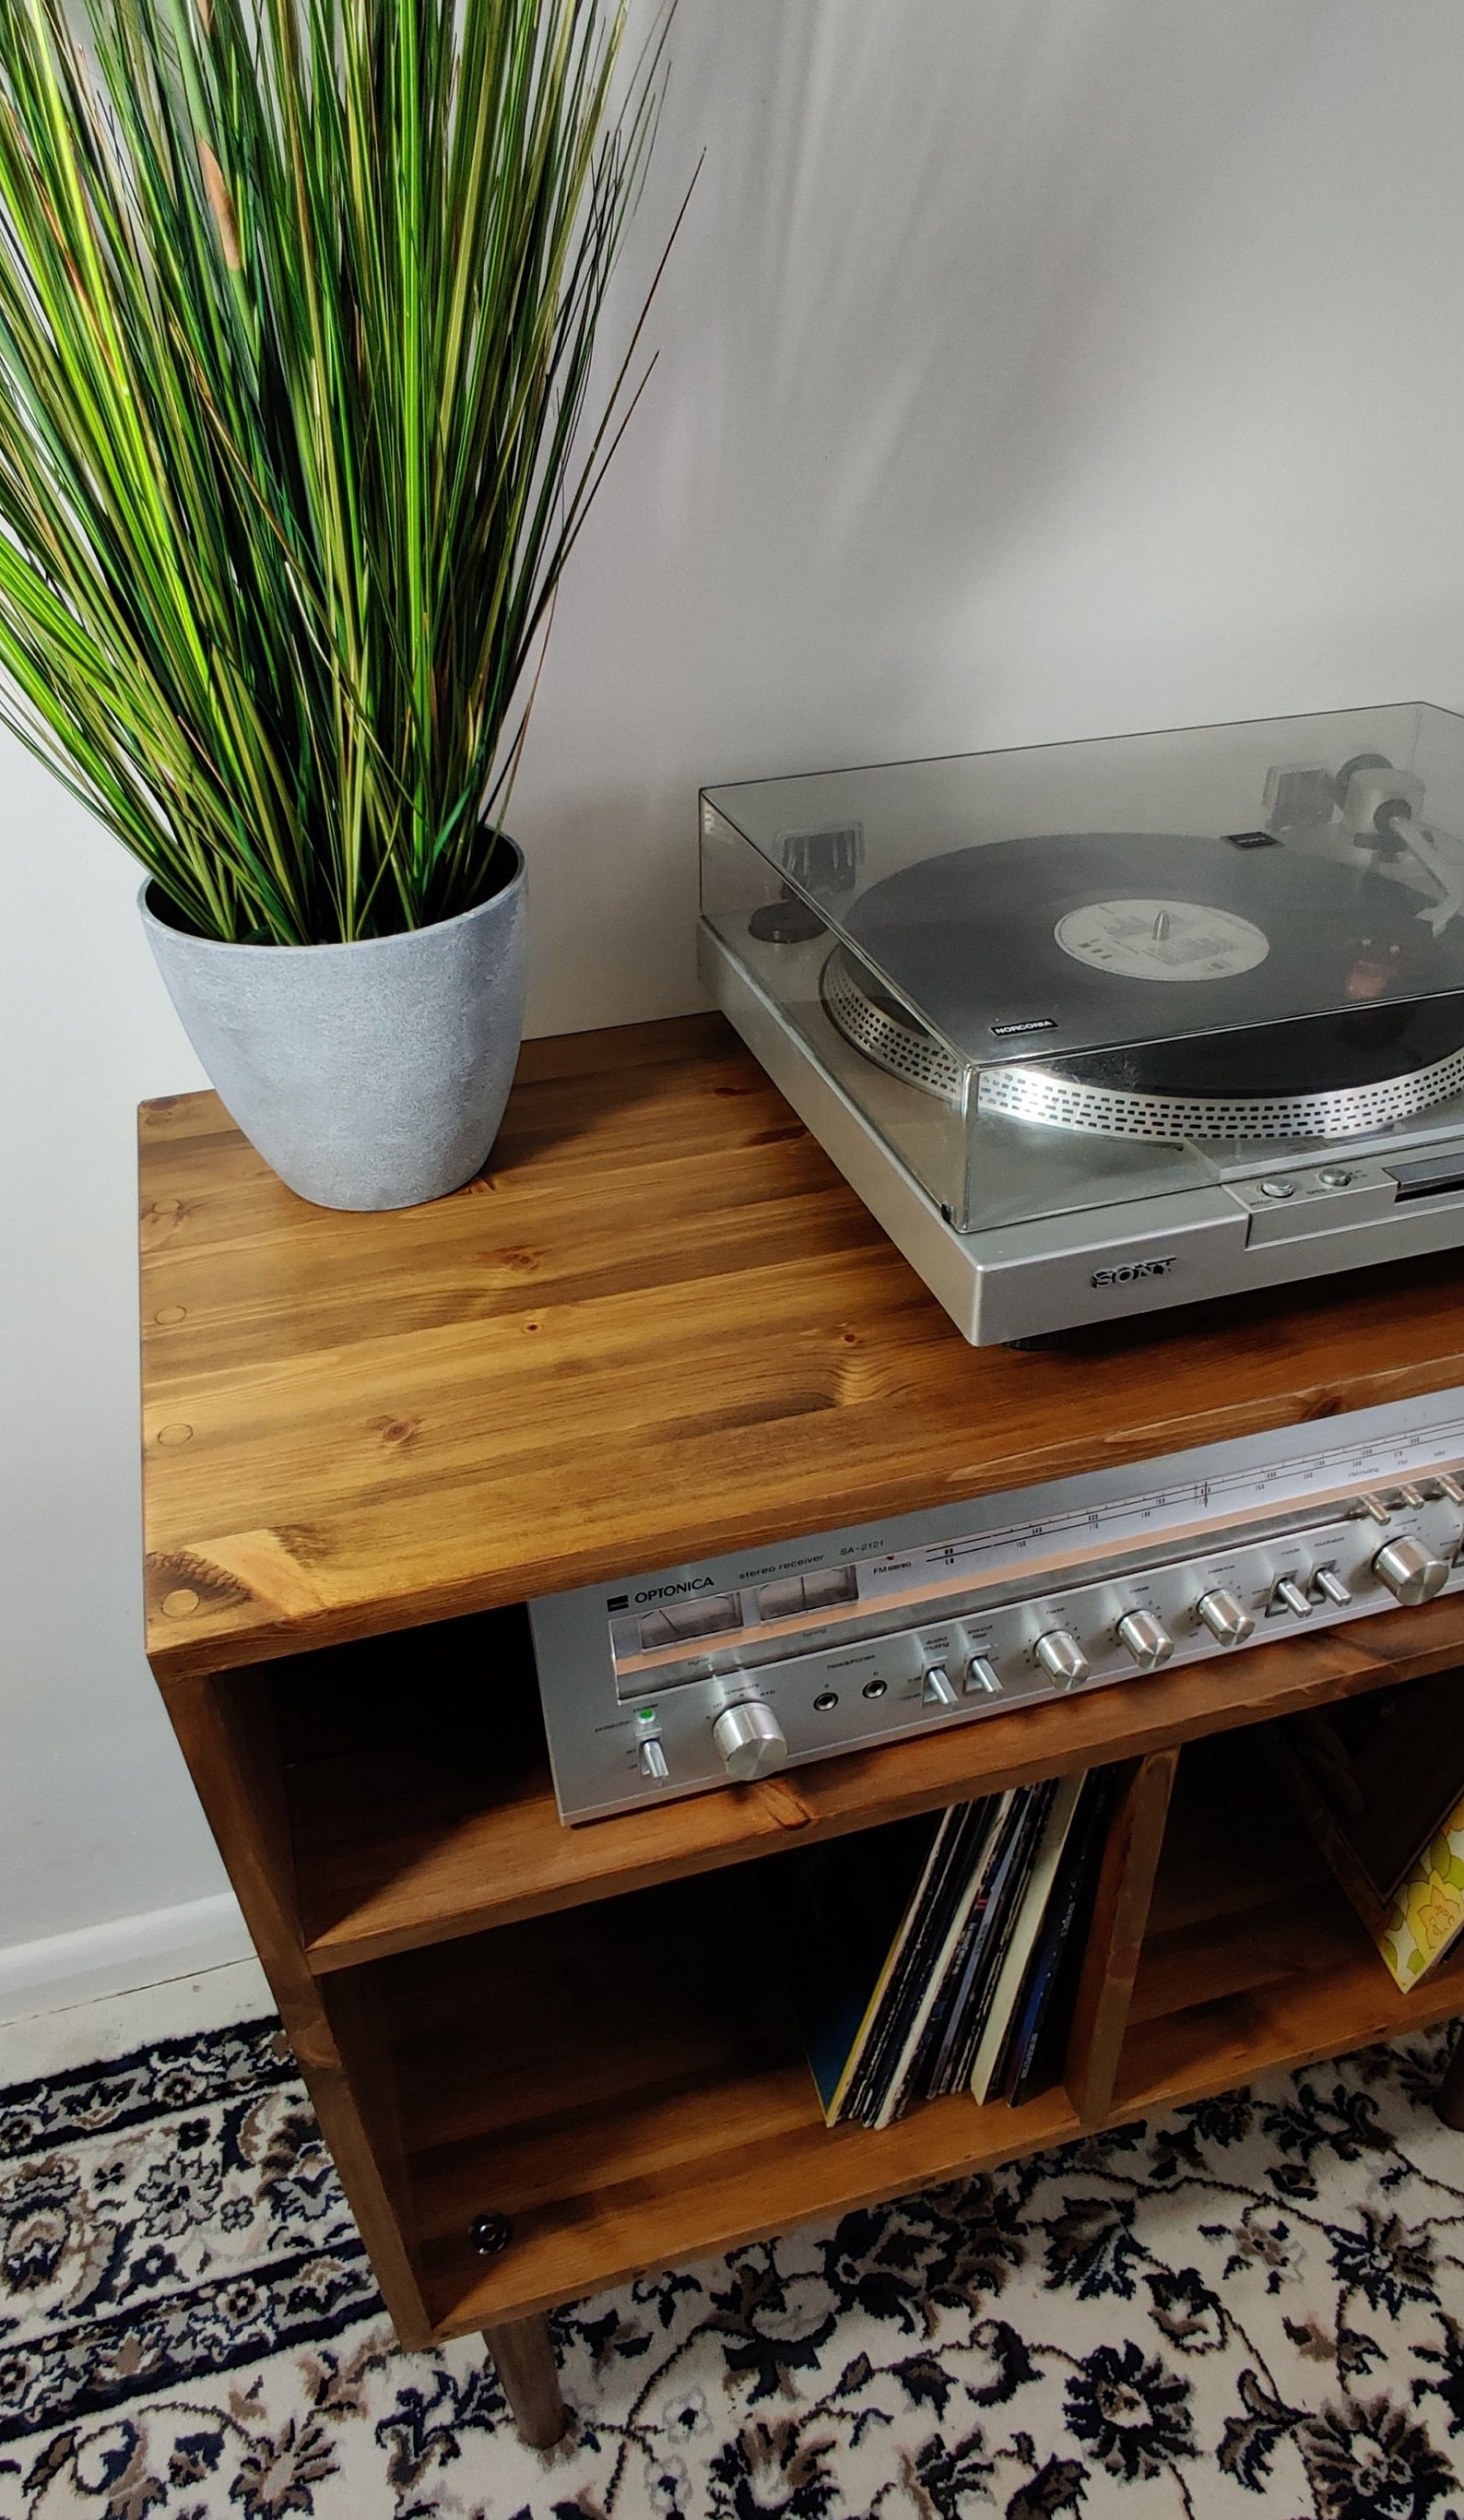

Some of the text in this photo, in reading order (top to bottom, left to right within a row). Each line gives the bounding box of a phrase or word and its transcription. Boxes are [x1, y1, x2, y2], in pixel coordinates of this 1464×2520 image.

[1091, 1256, 1177, 1289] SONY
[840, 1540, 884, 1556] SA-2121
[738, 1554, 825, 1579] stereo receiver
[634, 1577, 714, 1603] OPTONICA
